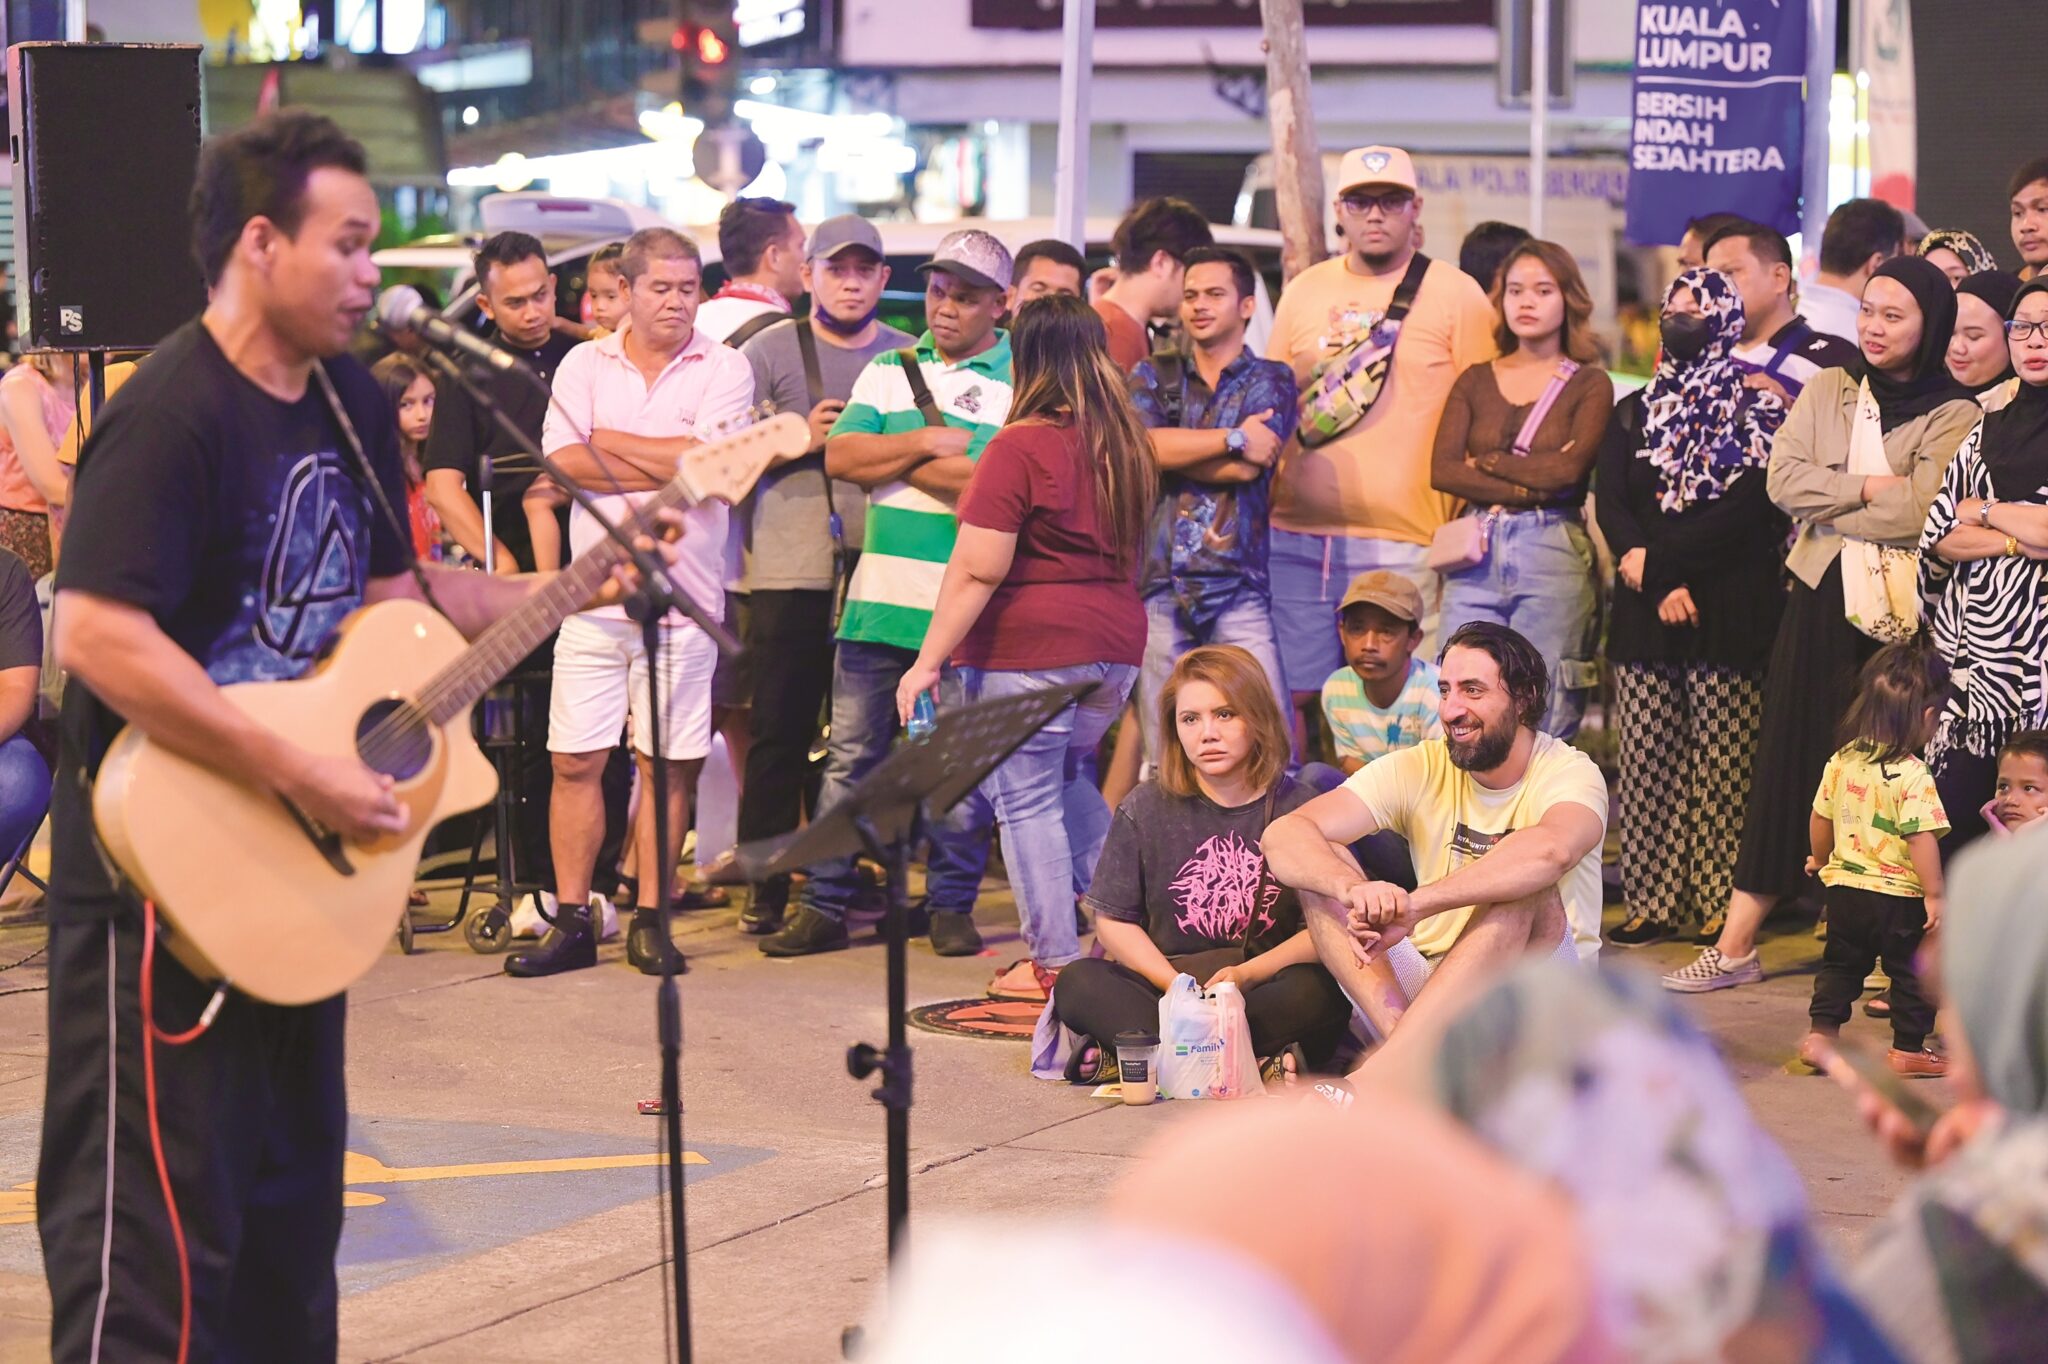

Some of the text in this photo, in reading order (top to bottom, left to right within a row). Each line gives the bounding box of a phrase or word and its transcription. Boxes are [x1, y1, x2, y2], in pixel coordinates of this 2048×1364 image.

[1640, 4, 1747, 39] KUALA
[1638, 37, 1772, 73] LUMPUR
[1636, 91, 1727, 122] BERSIH
[1634, 118, 1714, 147] INDAH
[1633, 144, 1785, 175] SEJAHTERA
